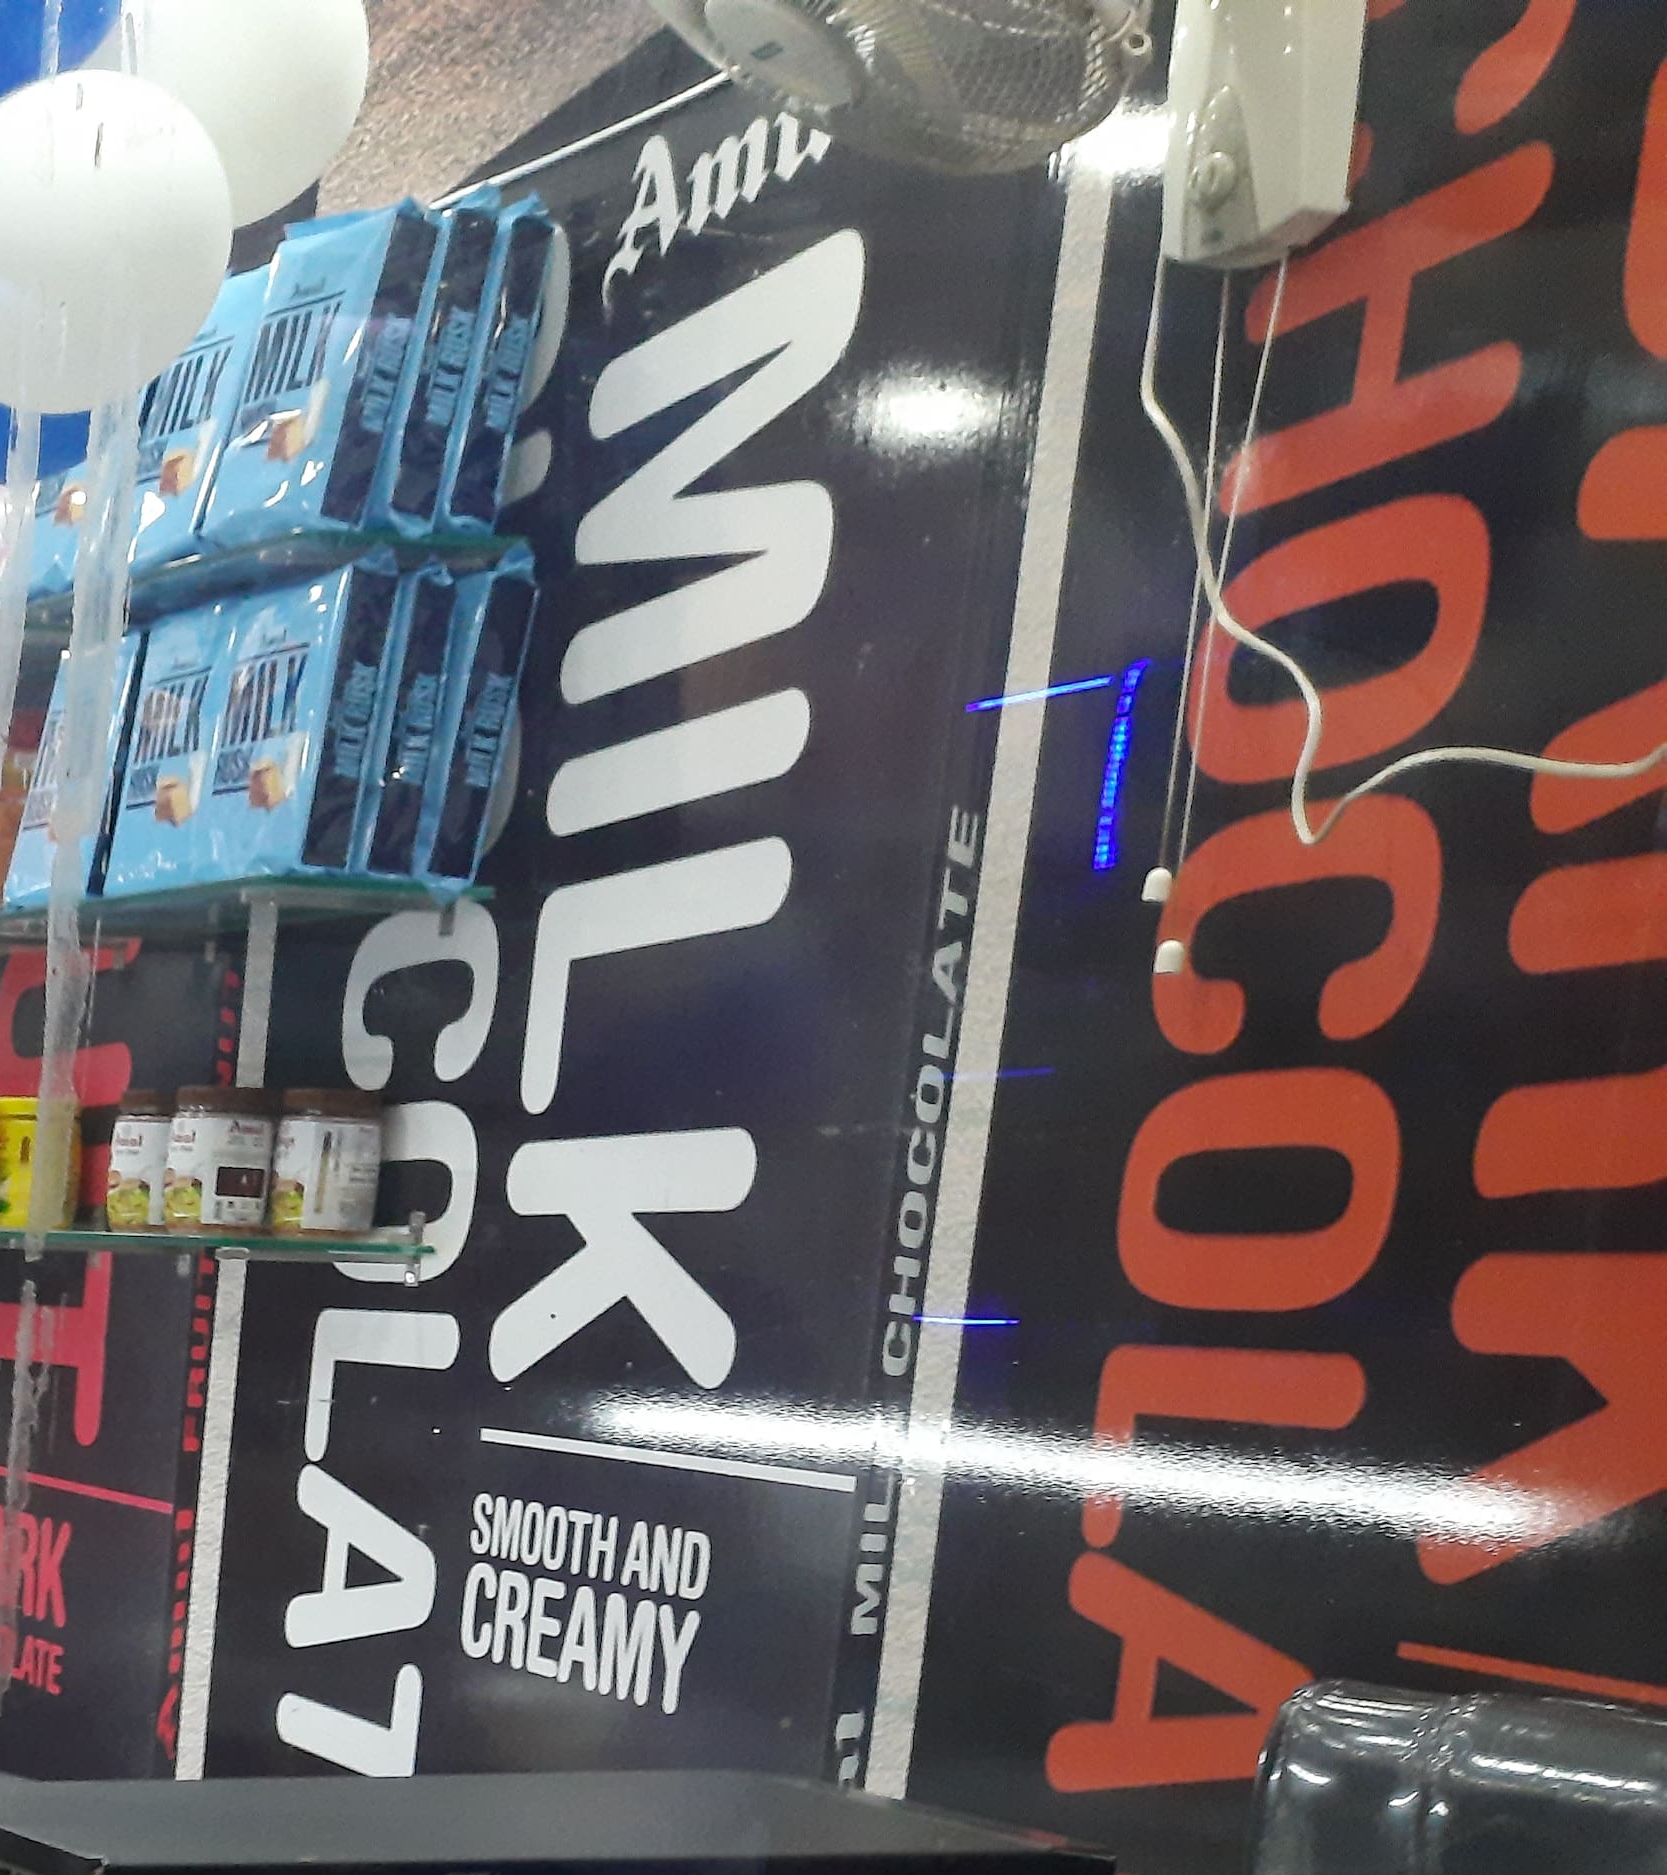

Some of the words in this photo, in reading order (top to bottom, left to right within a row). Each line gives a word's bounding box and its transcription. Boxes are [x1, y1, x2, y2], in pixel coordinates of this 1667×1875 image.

[244, 301, 342, 403] MILK
[487, 228, 866, 1390] MILK
[880, 803, 982, 1378] CHOCOLATE
[470, 1491, 620, 1581] SMOOTH
[620, 1521, 713, 1602] AND
[460, 1562, 703, 1717] CREAMY
